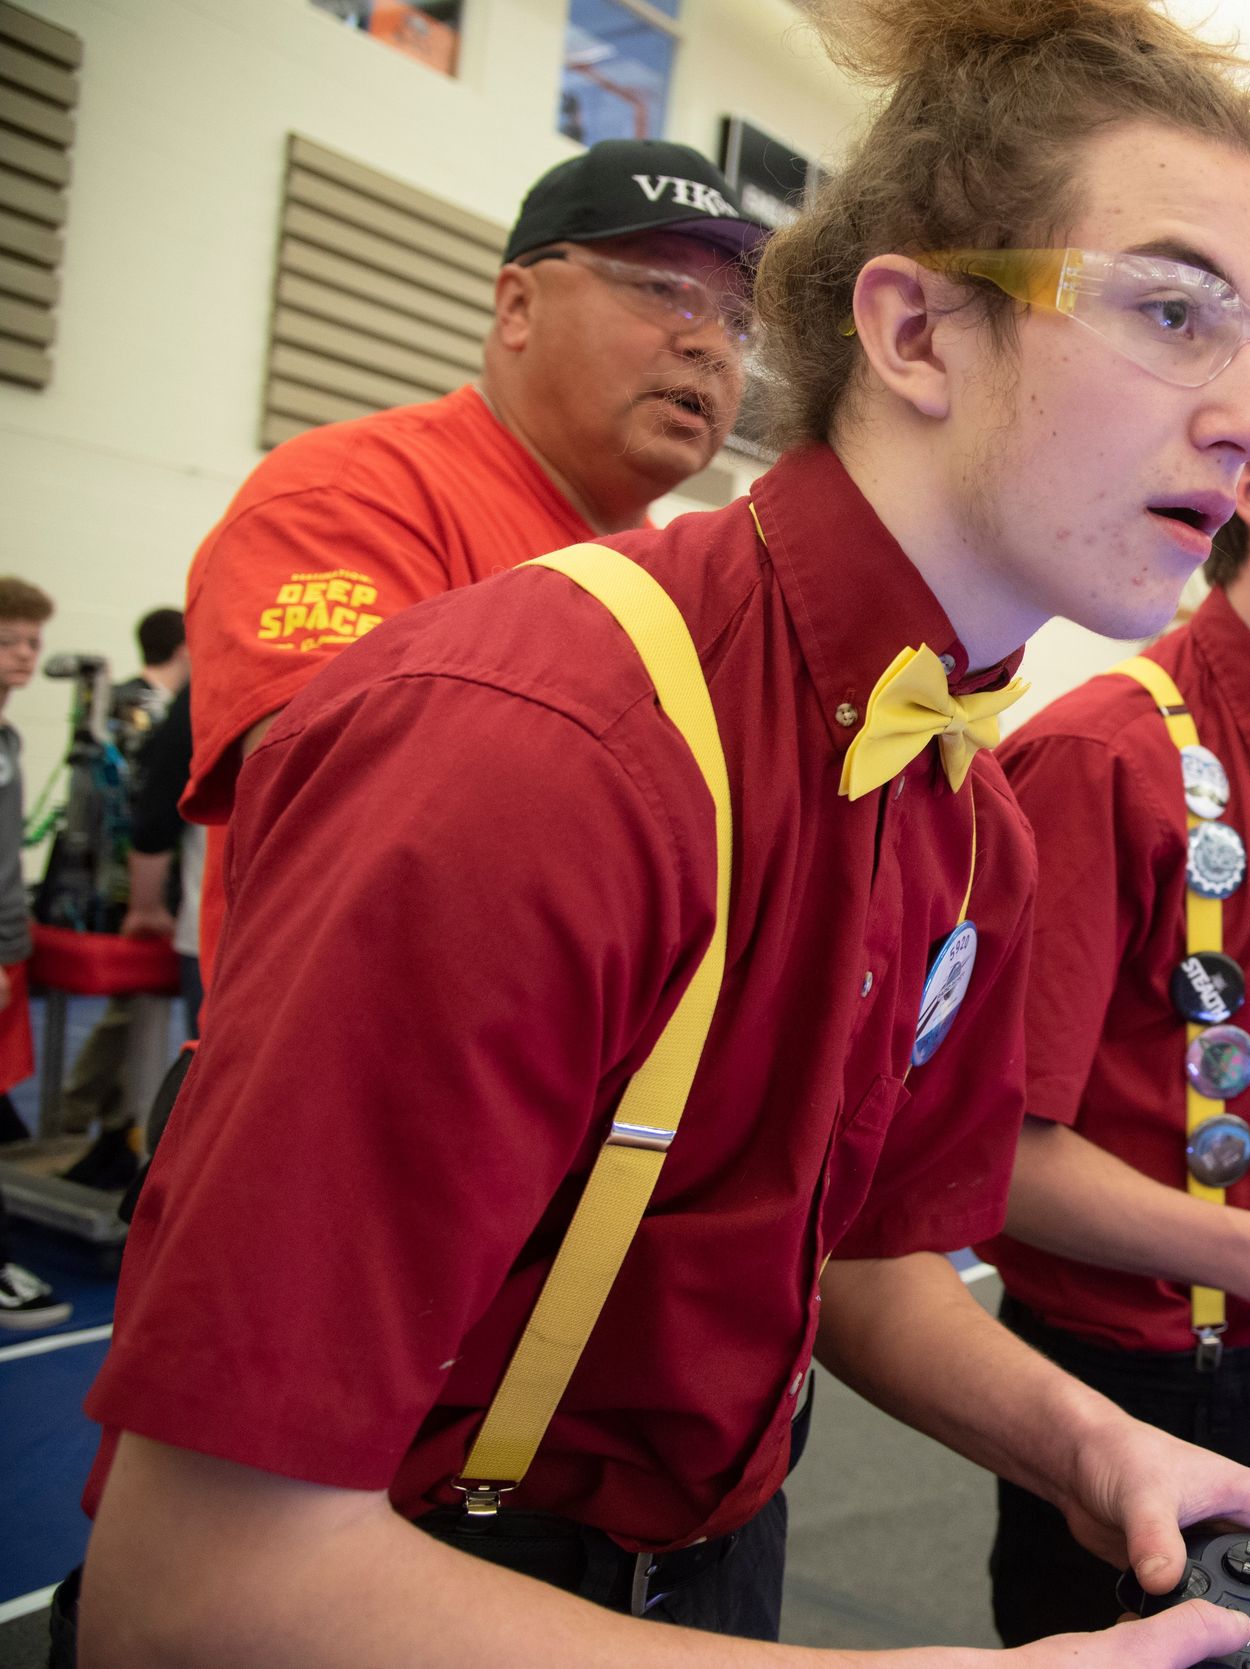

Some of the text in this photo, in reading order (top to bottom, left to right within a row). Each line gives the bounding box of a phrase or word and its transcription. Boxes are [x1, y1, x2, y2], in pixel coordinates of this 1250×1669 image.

[632, 174, 740, 217] VIK
[276, 579, 378, 608] DEEP
[257, 600, 384, 640] SPACE
[949, 934, 971, 961] 5920
